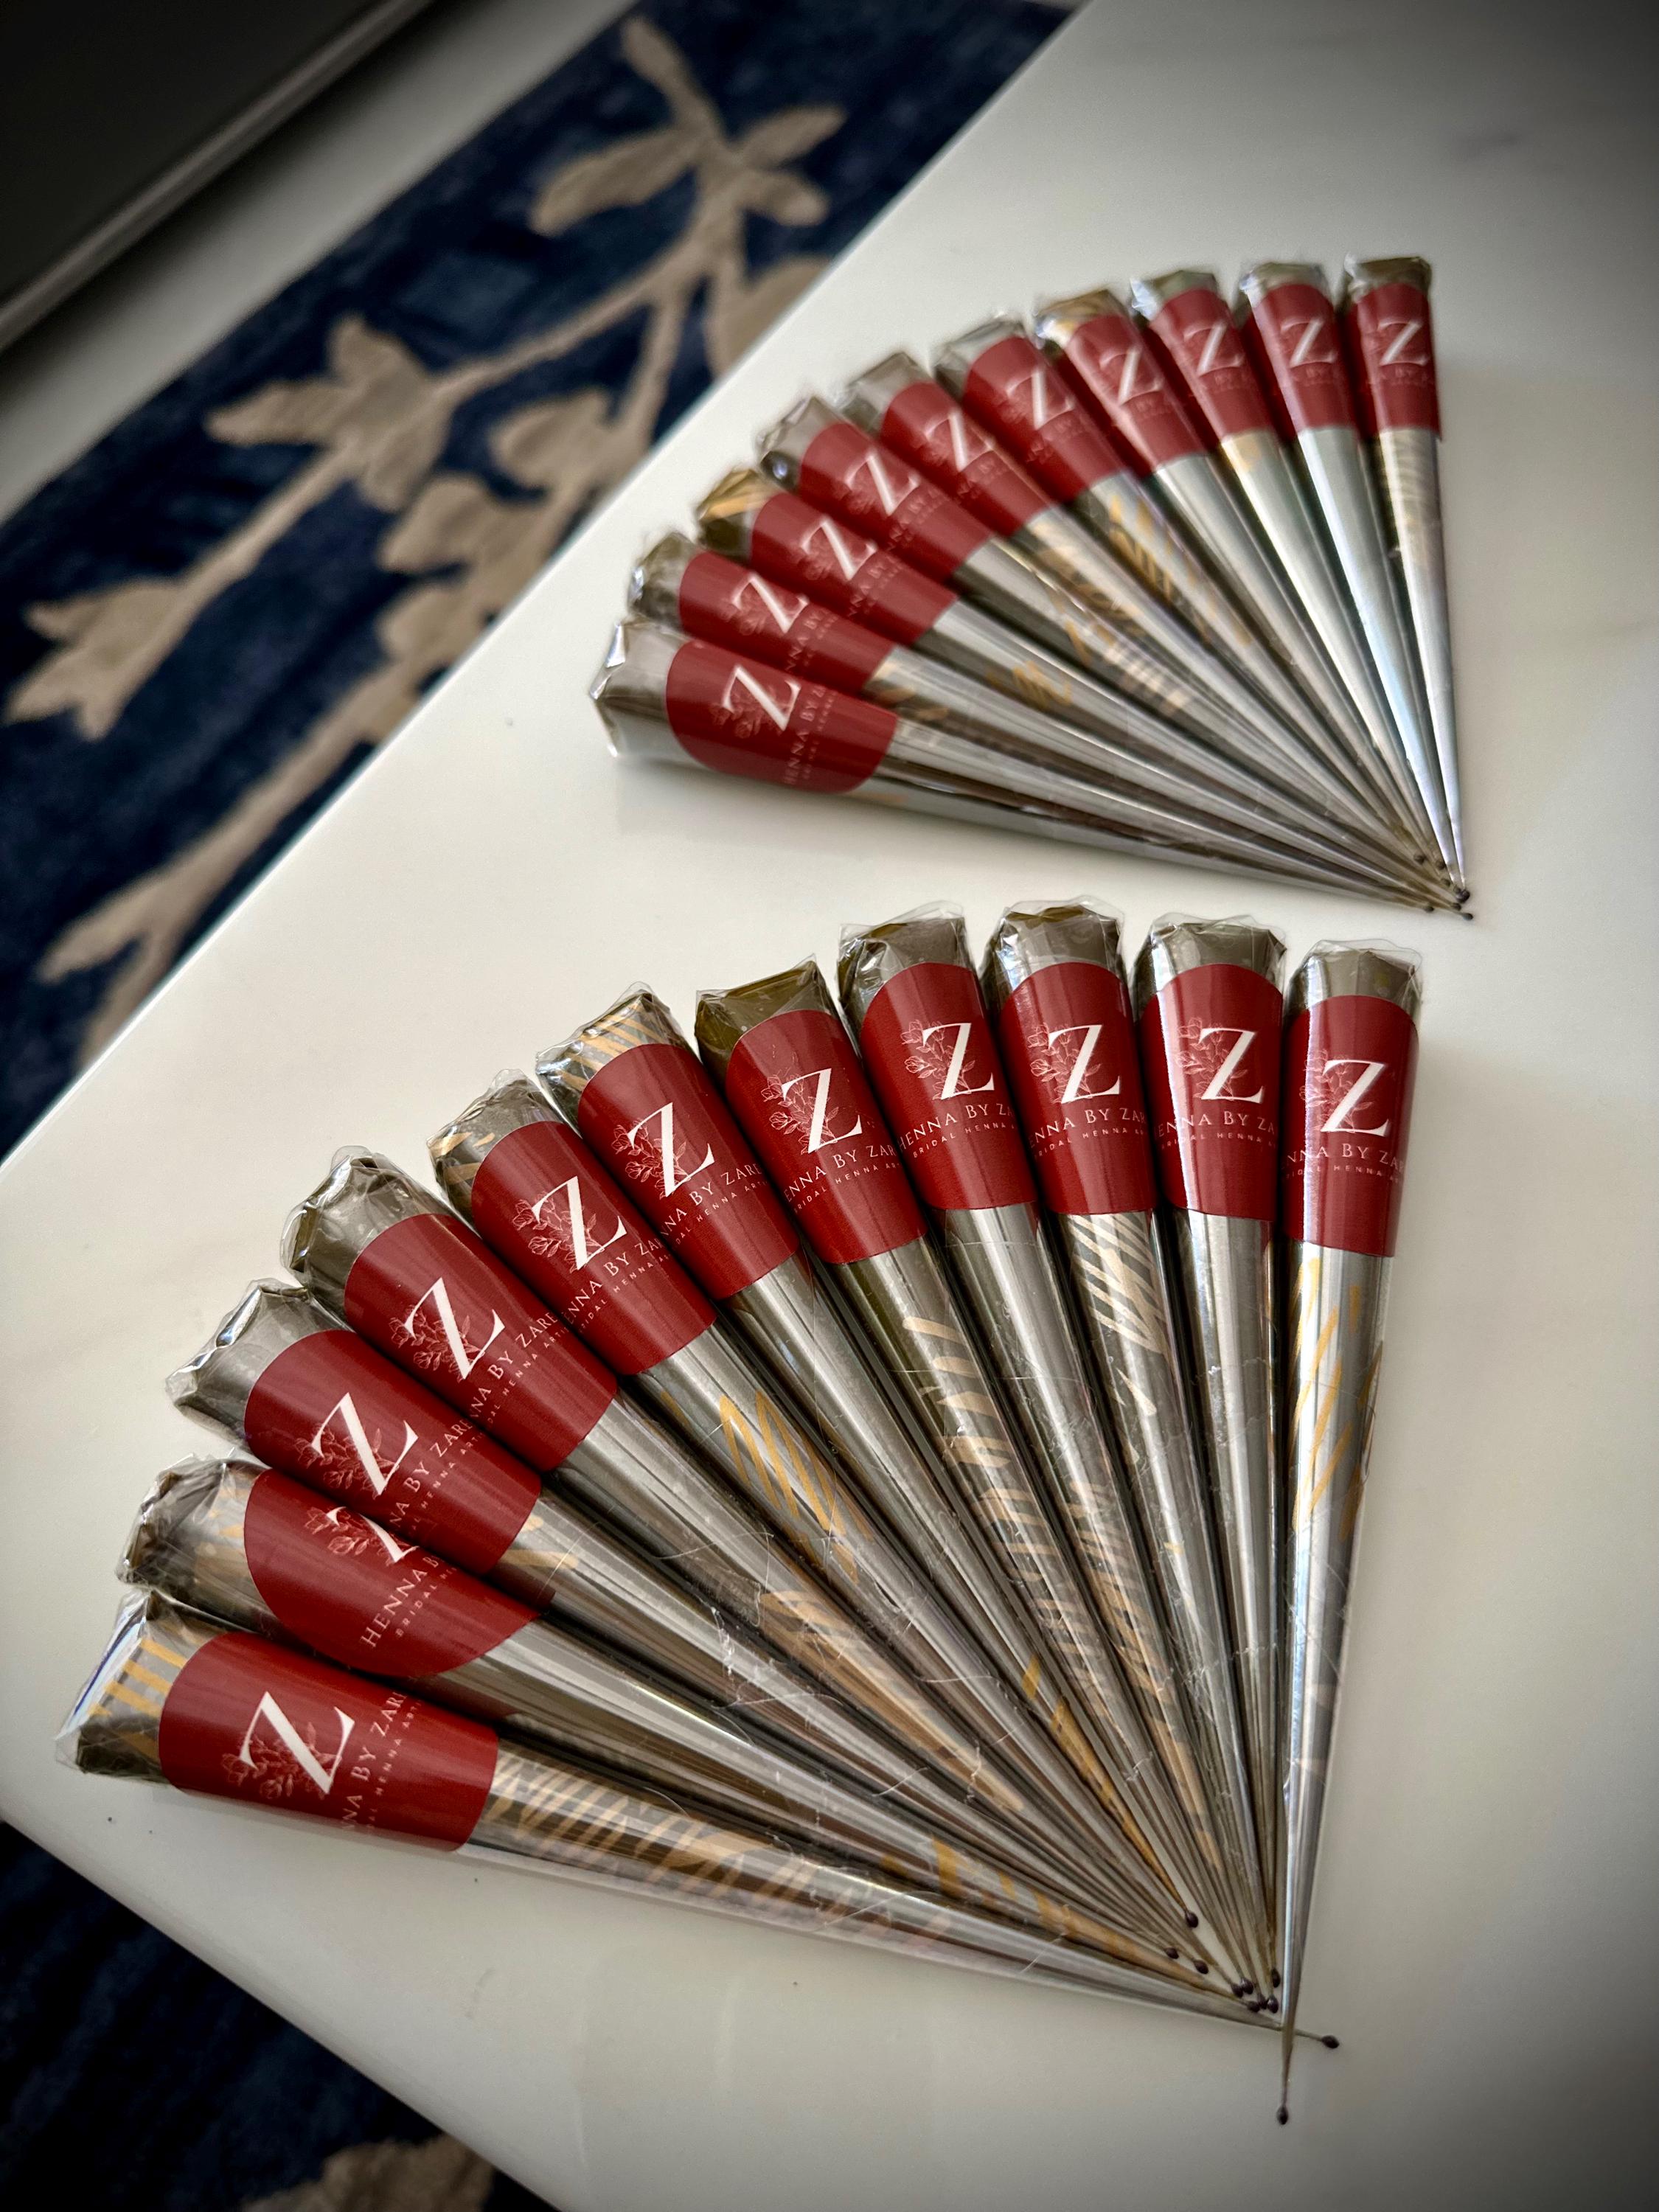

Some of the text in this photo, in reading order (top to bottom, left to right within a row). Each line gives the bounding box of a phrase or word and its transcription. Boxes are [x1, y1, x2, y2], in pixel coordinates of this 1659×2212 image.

[1183, 321, 1245, 378] Z
[1281, 318, 1338, 369] Z
[1377, 319, 1429, 366] Z
[1006, 367, 1075, 431] Z
[1099, 347, 1164, 406] Z
[923, 410, 995, 473] Z
[844, 448, 920, 516] Z
[800, 515, 877, 581] Z
[732, 572, 810, 633] Z
[722, 664, 801, 731] Z
[922, 1023, 995, 1100] Z
[1048, 1024, 1121, 1105] Z
[1197, 1028, 1264, 1104] Z
[782, 1068, 862, 1154] Z
[1085, 1108, 1110, 1124] BY
[1224, 1110, 1248, 1127] BY
[1321, 1060, 1389, 1137] Z
[627, 1102, 715, 1197] Z
[899, 1113, 958, 1150] HENNA
[965, 1104, 990, 1119] BY
[913, 1122, 1006, 1158] BRIDAL HENNA
[1082, 1127, 1128, 1139] HENNA
[1217, 1132, 1262, 1144] HENNA
[1342, 1143, 1369, 1160] BY
[832, 1149, 858, 1169] BY
[835, 1164, 879, 1185] HENNA
[1333, 1165, 1382, 1177] HENNA
[689, 1181, 714, 1206] BY
[696, 1192, 738, 1222] HENNA
[531, 1175, 627, 1270] Z
[602, 1251, 631, 1277] BY
[613, 1262, 655, 1294] HENNA
[404, 1277, 506, 1380] Z
[487, 1350, 514, 1380] BY
[502, 1353, 538, 1397] HENNA
[311, 1392, 419, 1496] Z
[403, 1459, 431, 1493] BY
[420, 1461, 456, 1510] HENNA
[359, 1569, 428, 1648] HENNA
[394, 1584, 438, 1638] BRIDAL
[239, 1691, 355, 1795] Z
[350, 1745, 377, 1782] BY
